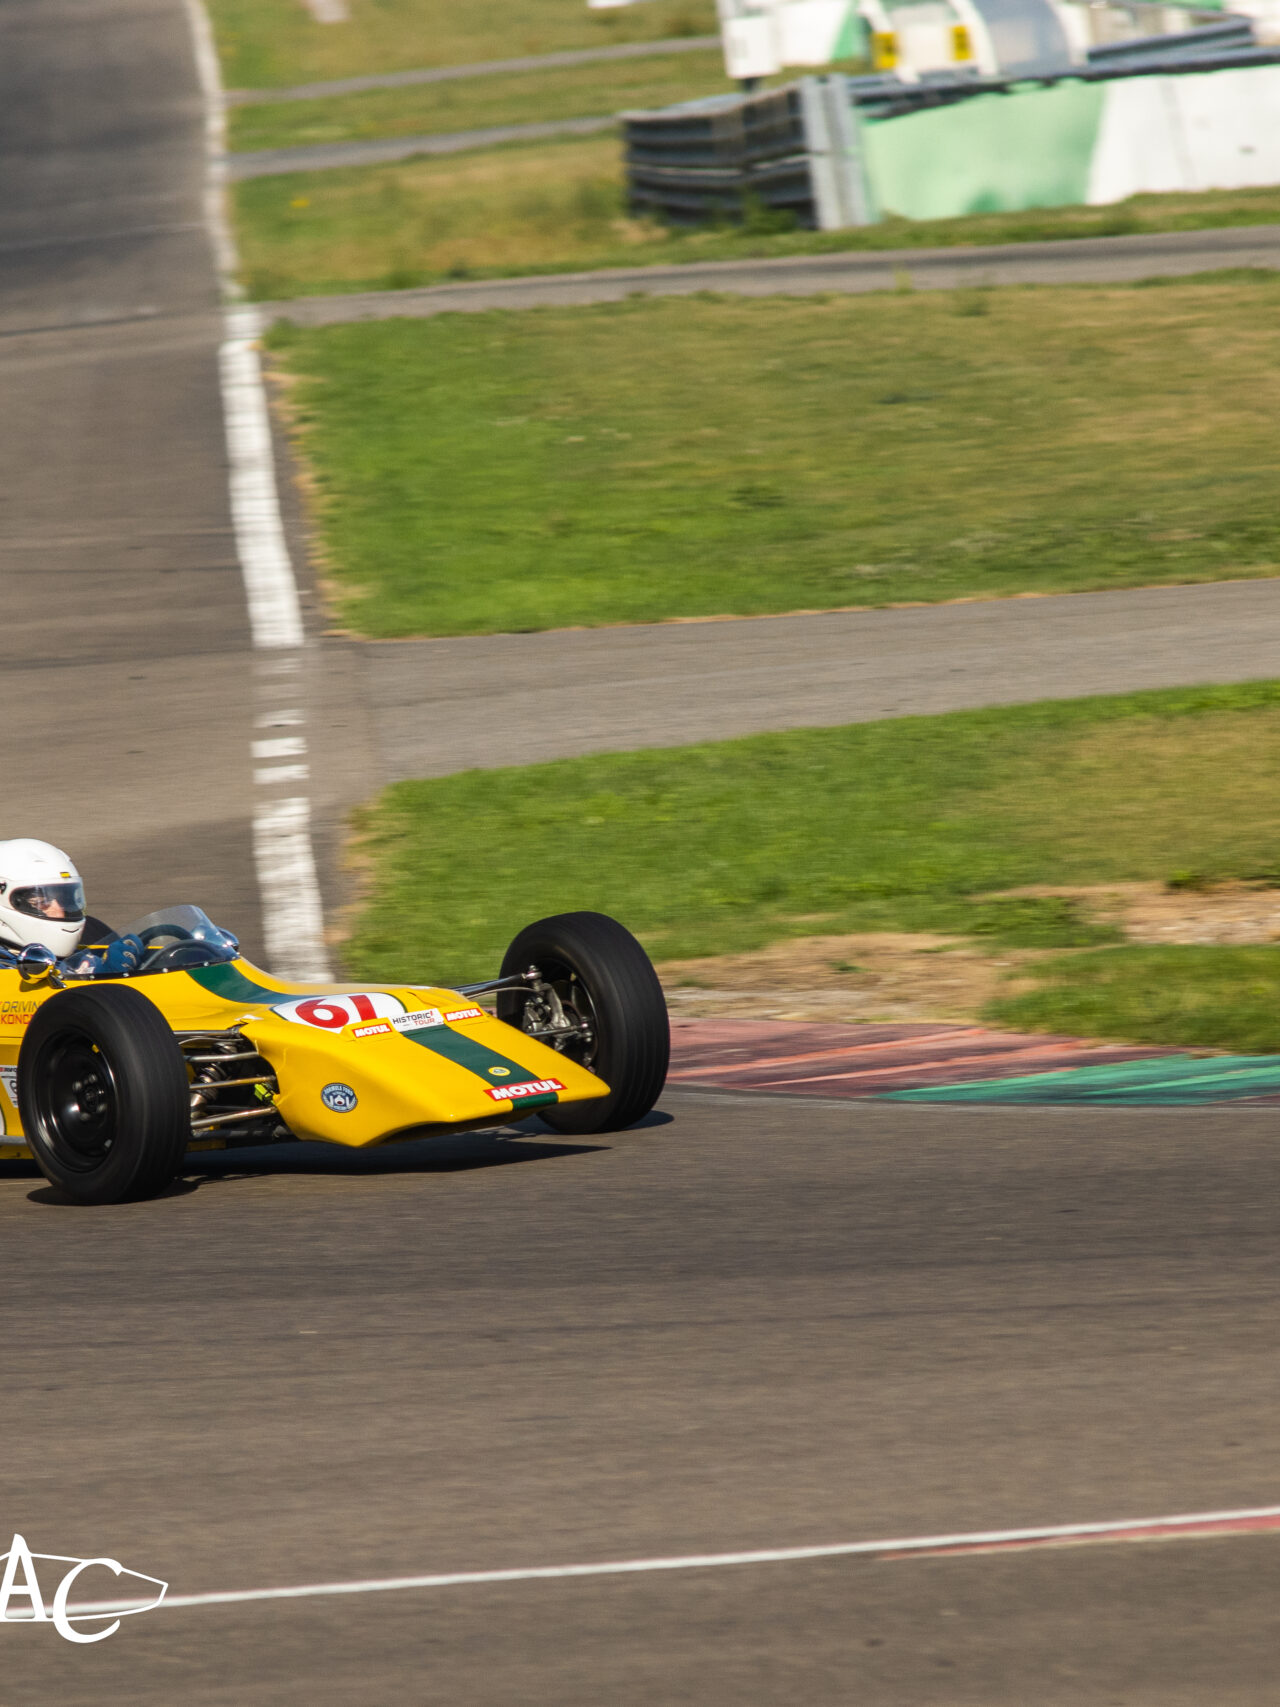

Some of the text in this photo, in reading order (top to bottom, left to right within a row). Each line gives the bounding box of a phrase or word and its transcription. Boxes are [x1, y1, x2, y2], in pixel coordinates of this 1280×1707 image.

[1, 1000, 41, 1013] DRIVIN
[295, 995, 377, 1028] 61
[446, 1008, 482, 1021] MOTUL
[414, 1017, 436, 1026] TOUR
[354, 1024, 391, 1038] MOTUL
[490, 1079, 562, 1100] MOTUL
